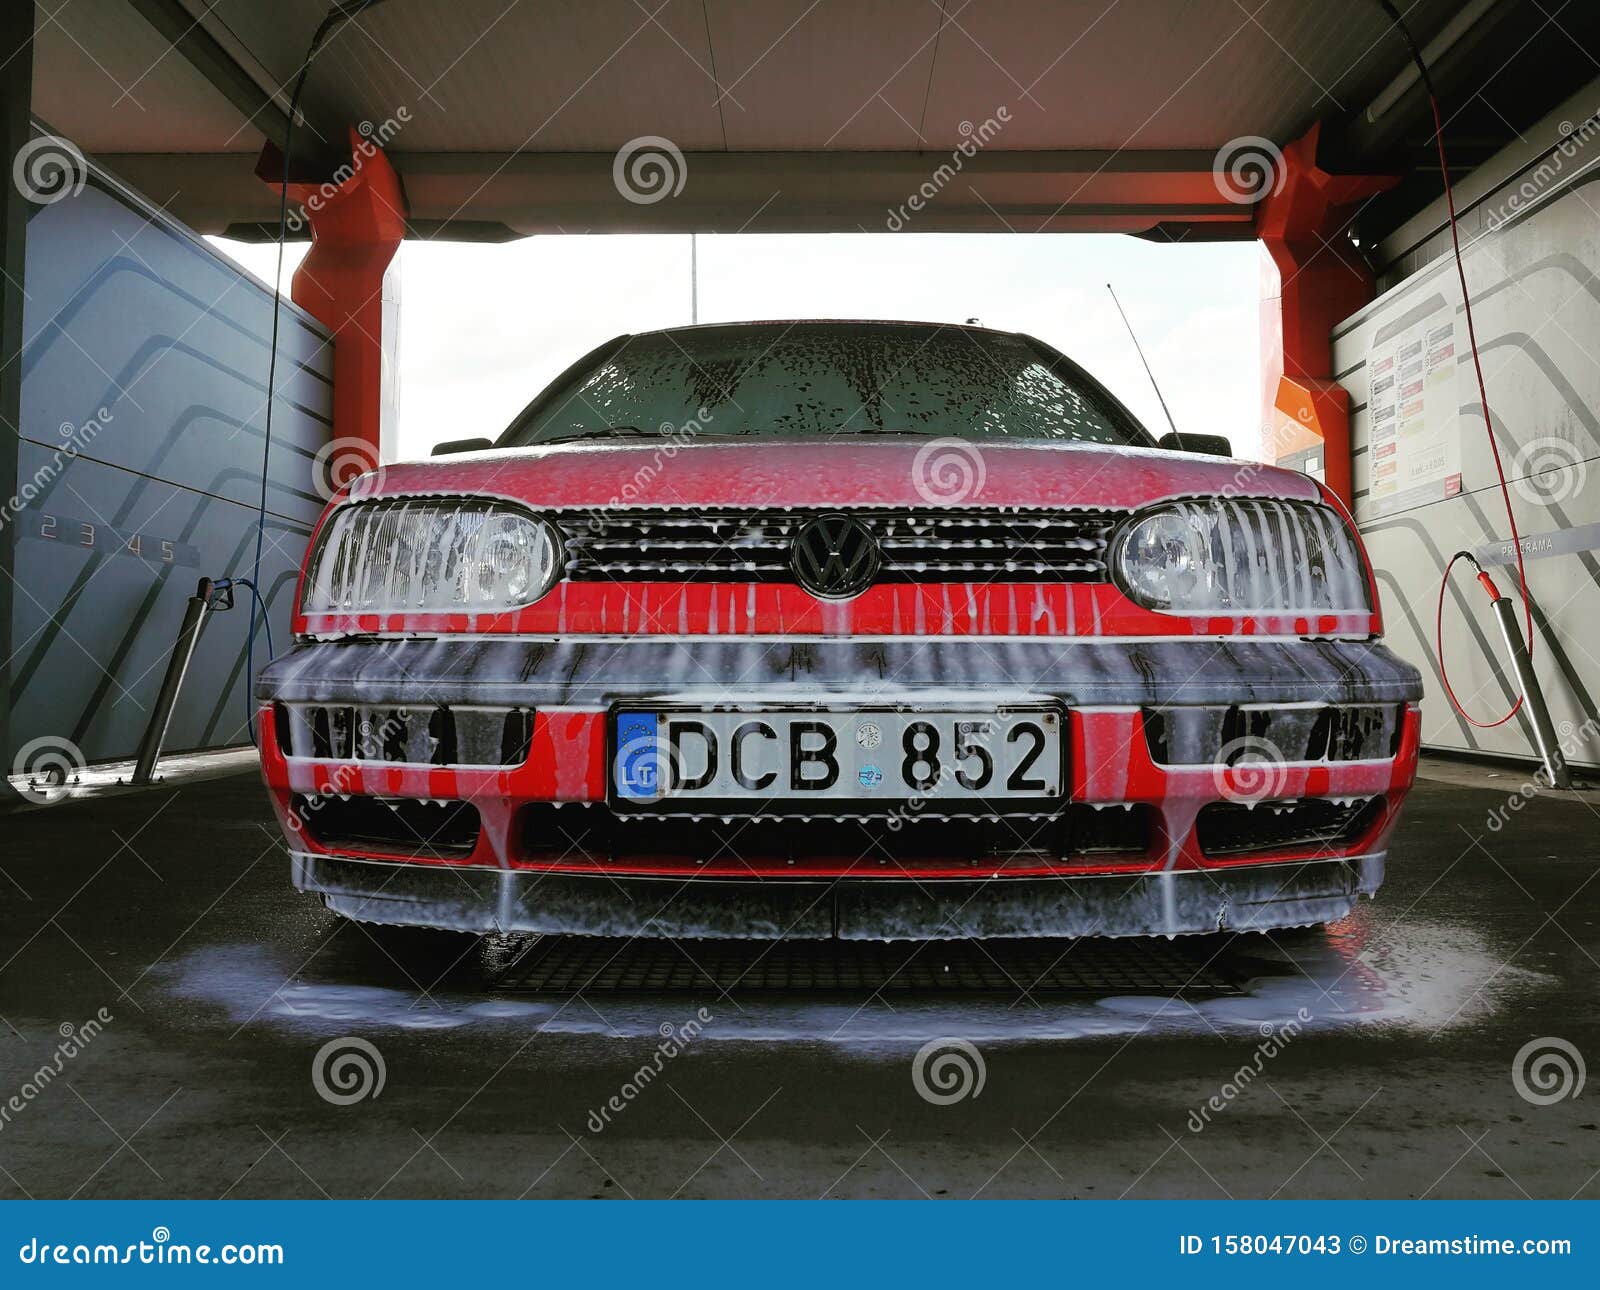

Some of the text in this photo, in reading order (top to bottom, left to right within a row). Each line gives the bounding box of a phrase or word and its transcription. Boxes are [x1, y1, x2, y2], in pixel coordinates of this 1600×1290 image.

[621, 766, 653, 786] LT
[668, 720, 1047, 791] DCB 852
